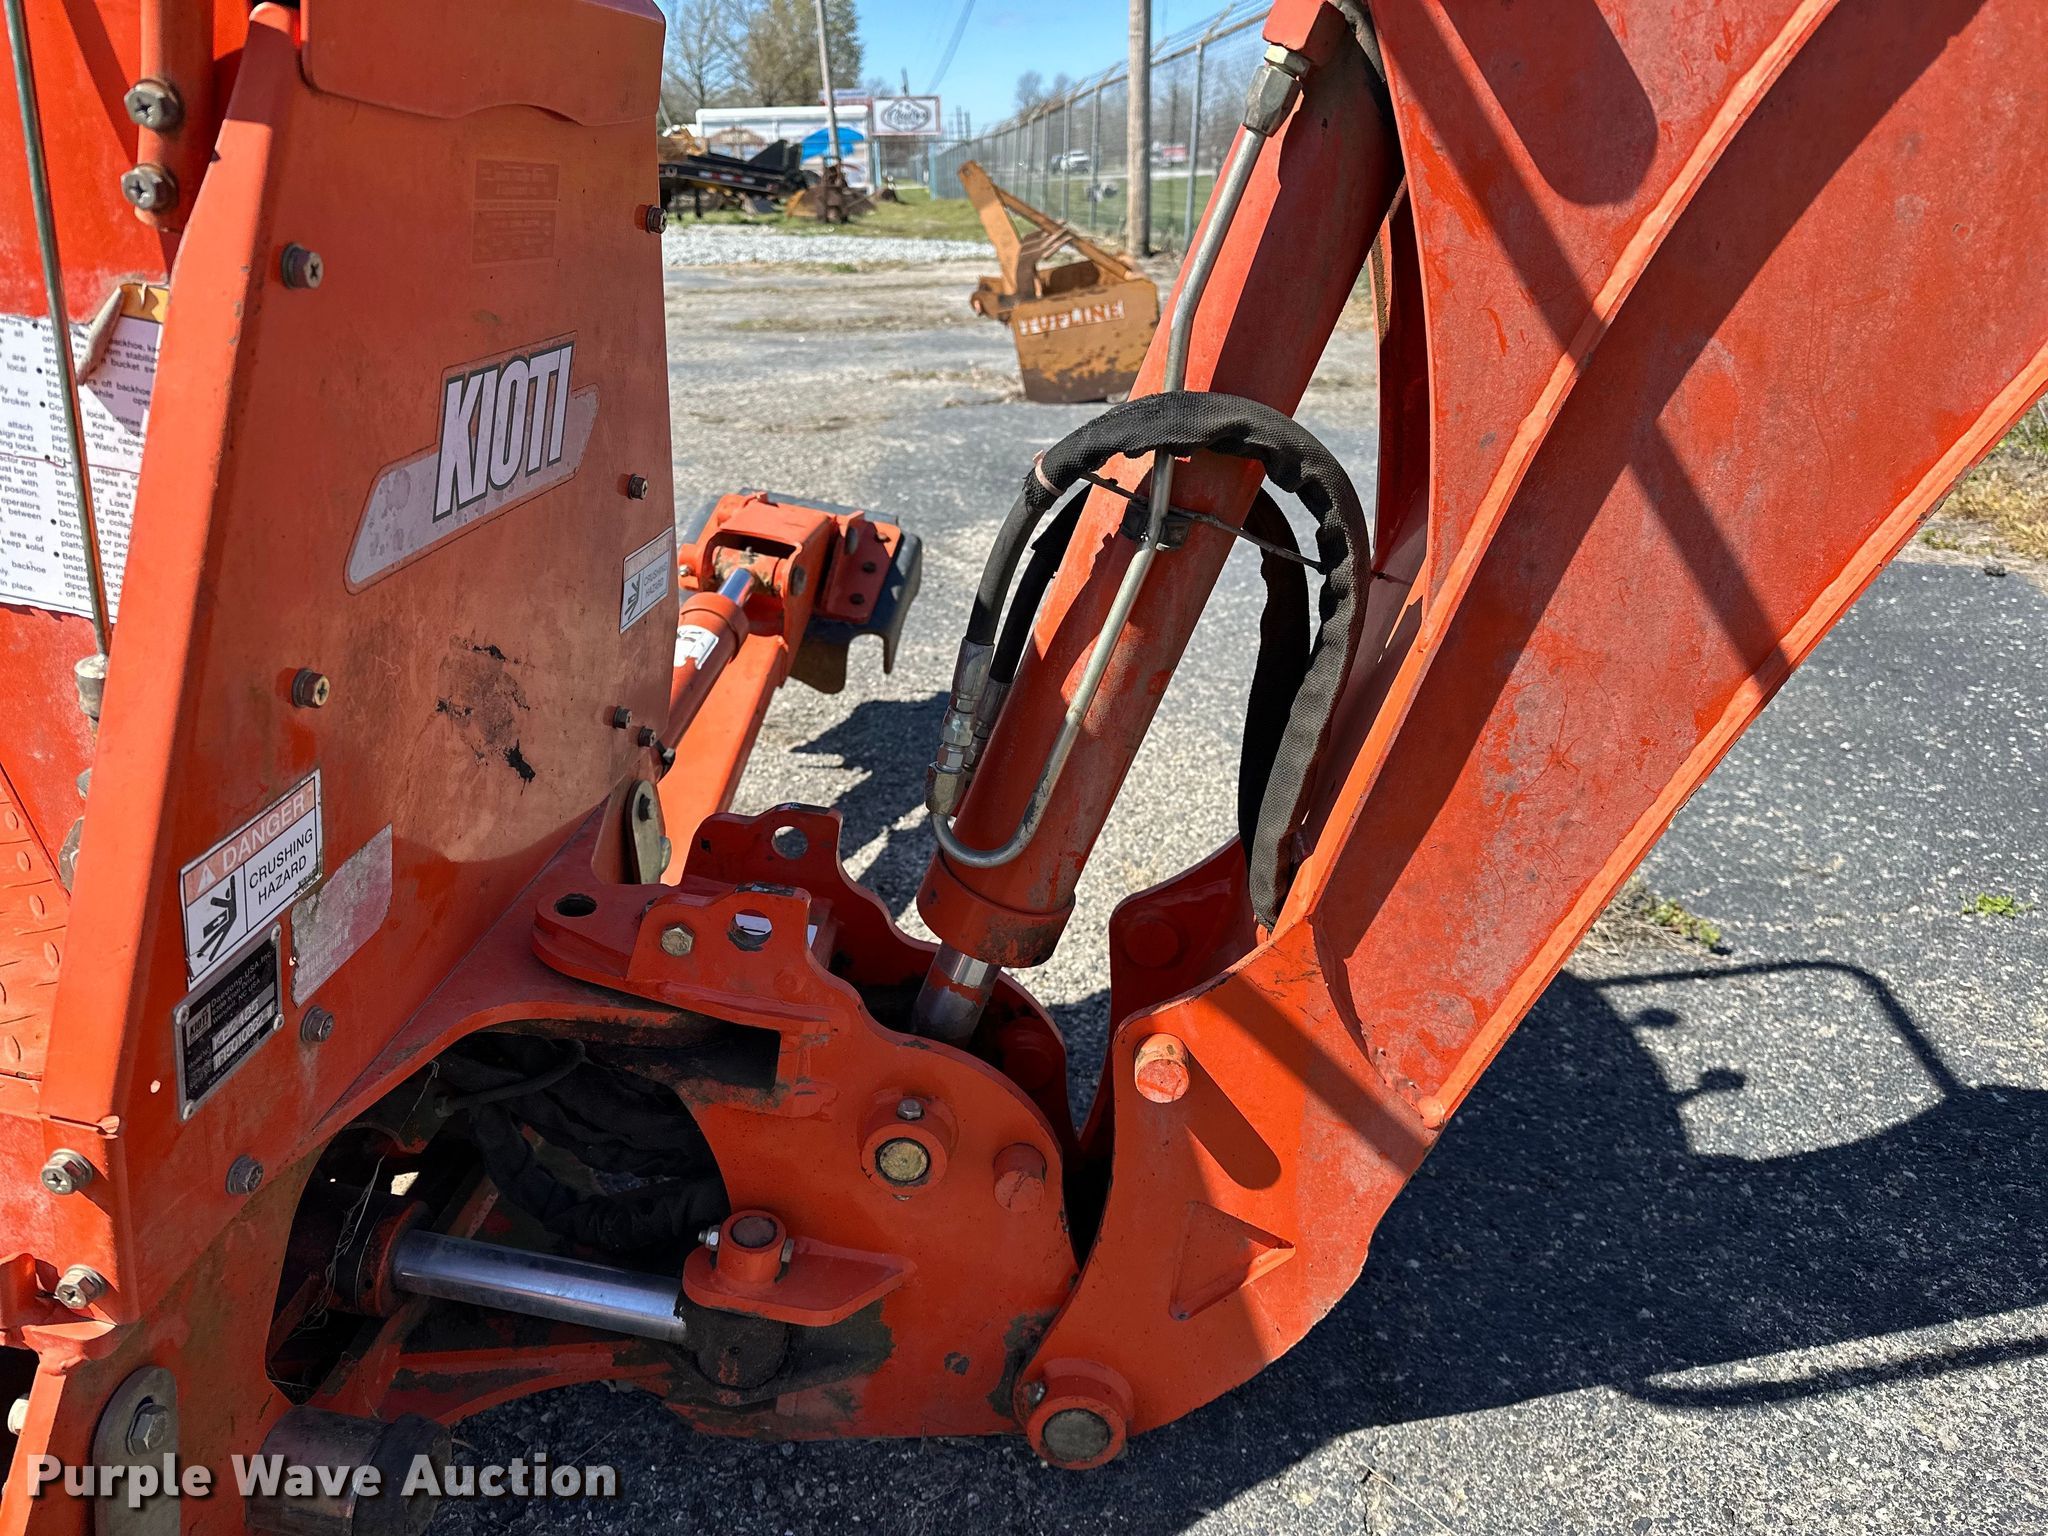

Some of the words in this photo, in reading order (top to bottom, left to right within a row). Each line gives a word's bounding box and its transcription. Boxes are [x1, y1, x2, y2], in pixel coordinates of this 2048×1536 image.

[6, 361, 28, 373] local
[111, 358, 140, 371] bucket
[2, 396, 31, 408] broken
[86, 410, 106, 421] local
[8, 420, 34, 431] attach
[92, 421, 115, 432] Know
[18, 433, 34, 442] and
[432, 341, 575, 524] KIOTI
[94, 442, 119, 453] Watch
[123, 447, 134, 456] for
[21, 459, 37, 468] and
[14, 466, 25, 475] be
[26, 470, 38, 478] on
[21, 478, 39, 488] with
[93, 477, 119, 487] unless
[116, 492, 132, 500] and
[1, 497, 41, 511] operators
[109, 499, 130, 509] Loss
[8, 507, 42, 521] between
[105, 509, 126, 518] parts
[60, 520, 71, 528] Do
[107, 529, 122, 538] this
[9, 530, 27, 540] area
[35, 535, 44, 543] of
[1, 538, 21, 549] keep
[25, 543, 45, 554] solid
[11, 560, 47, 574] backhoe
[222, 793, 306, 873] DANGER
[249, 828, 313, 889] CRUSHING
[258, 855, 307, 905] HAZARD
[248, 979, 260, 992] USA
[190, 1010, 209, 1036] KIOTI
